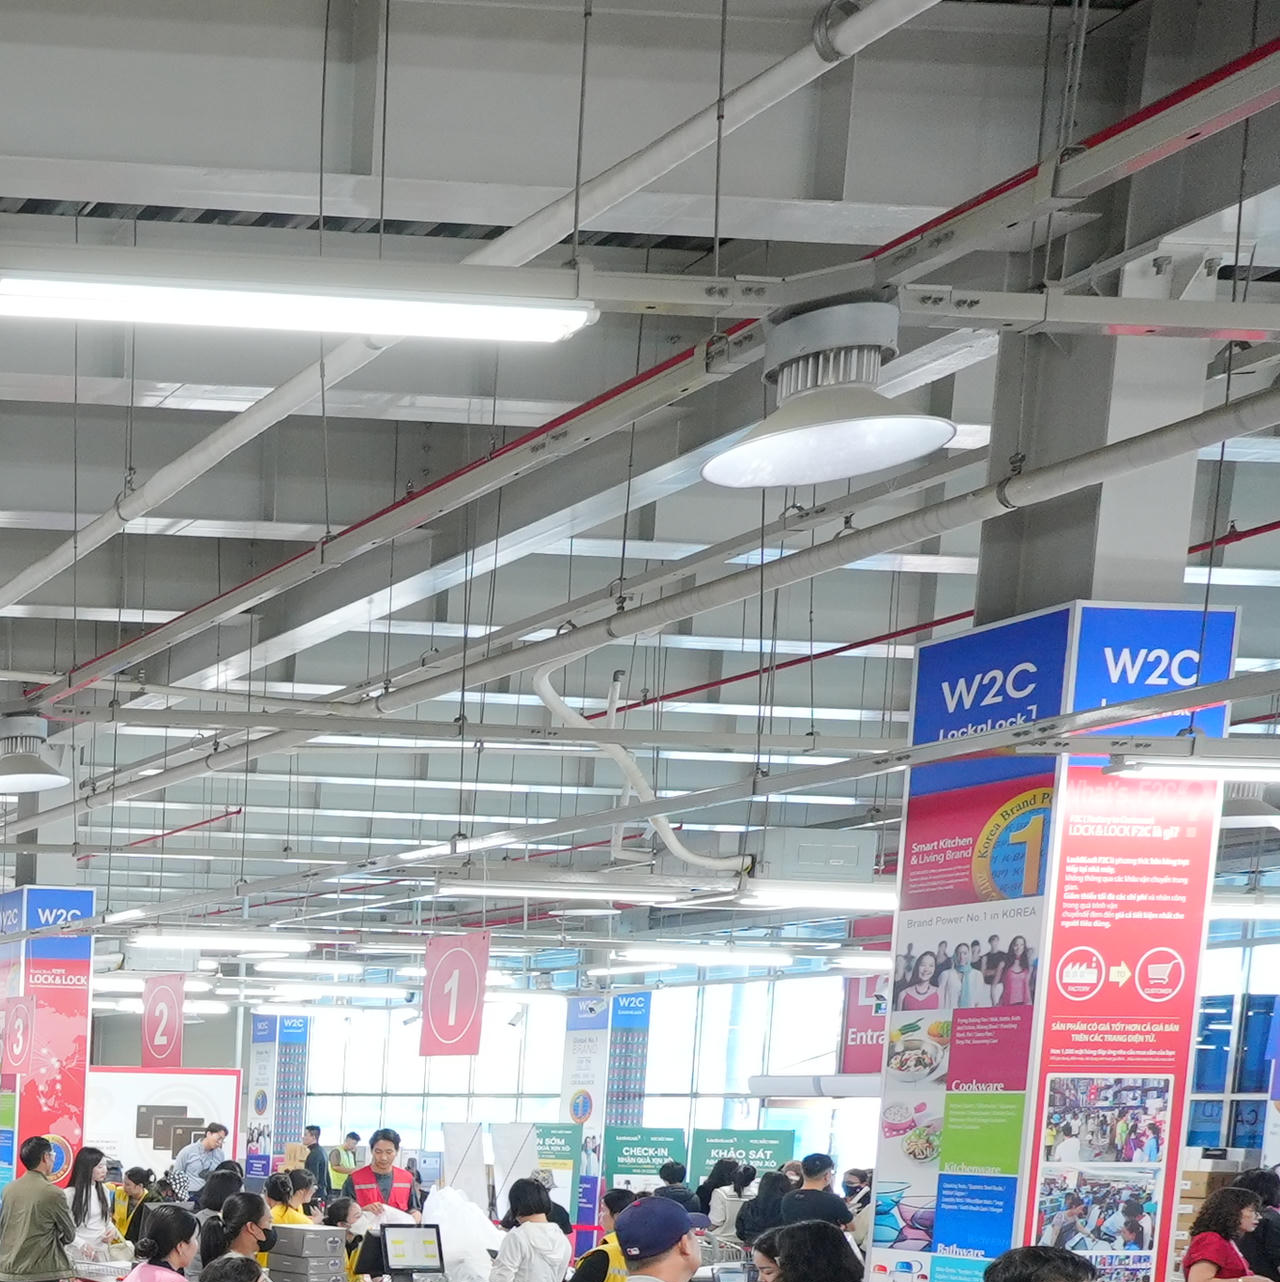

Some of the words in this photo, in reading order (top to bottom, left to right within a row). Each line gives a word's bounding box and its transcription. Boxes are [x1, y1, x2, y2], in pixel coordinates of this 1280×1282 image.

[1104, 647, 1200, 686] W2C
[941, 662, 1038, 714] W2C
[977, 822, 1001, 859] Korea
[1000, 794, 1037, 822] Brand
[1069, 825, 1131, 837] LOCK&LOCK
[911, 841, 938, 854] Smart
[939, 837, 973, 850] Kitchen
[910, 855, 919, 865] &
[919, 853, 945, 865] Living
[946, 847, 972, 860] Brand
[1009, 814, 1045, 896] 1
[0, 908, 19, 928] W2C
[907, 917, 934, 929] Brand
[935, 915, 964, 927] Power
[1001, 907, 1037, 918] KOREA
[29, 974, 87, 985] LOCK&LOCK
[443, 968, 460, 1027] 1
[618, 997, 645, 1008] W2C
[152, 1001, 169, 1047] 2
[284, 1018, 304, 1028] W2C
[13, 1017, 23, 1055] 3
[951, 1079, 1005, 1092] Cookware
[622, 1147, 668, 1157] CHECK-IN
[711, 1147, 745, 1159] KHẢO
[748, 1147, 773, 1159] SÁT
[944, 1162, 1002, 1174] Kitchenware
[936, 1243, 985, 1258] Bathware
